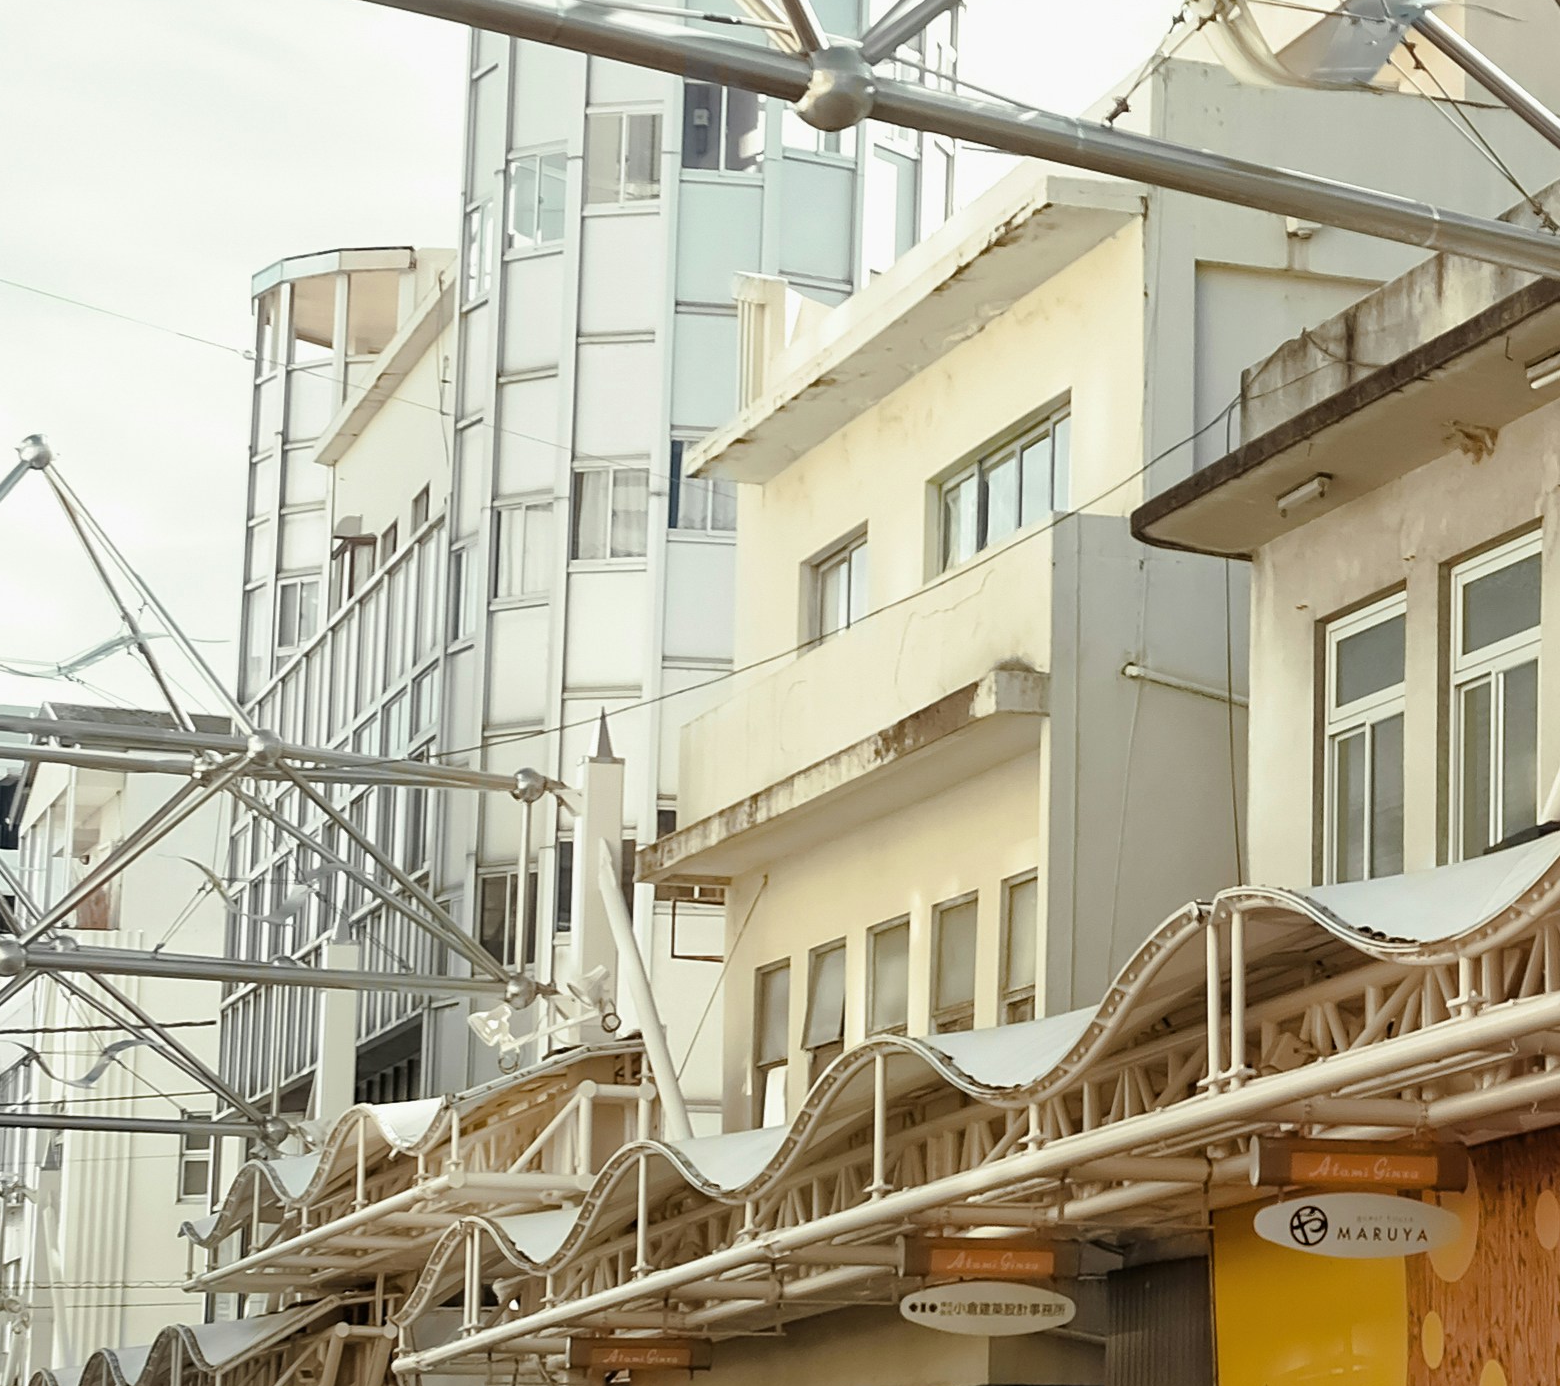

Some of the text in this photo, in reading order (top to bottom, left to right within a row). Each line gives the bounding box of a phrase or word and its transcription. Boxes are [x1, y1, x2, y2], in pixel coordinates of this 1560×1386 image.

[1309, 1155, 1420, 1181] Atami Ginza
[1337, 1227, 1428, 1242] MARUYA
[602, 1349, 645, 1363] Atami
